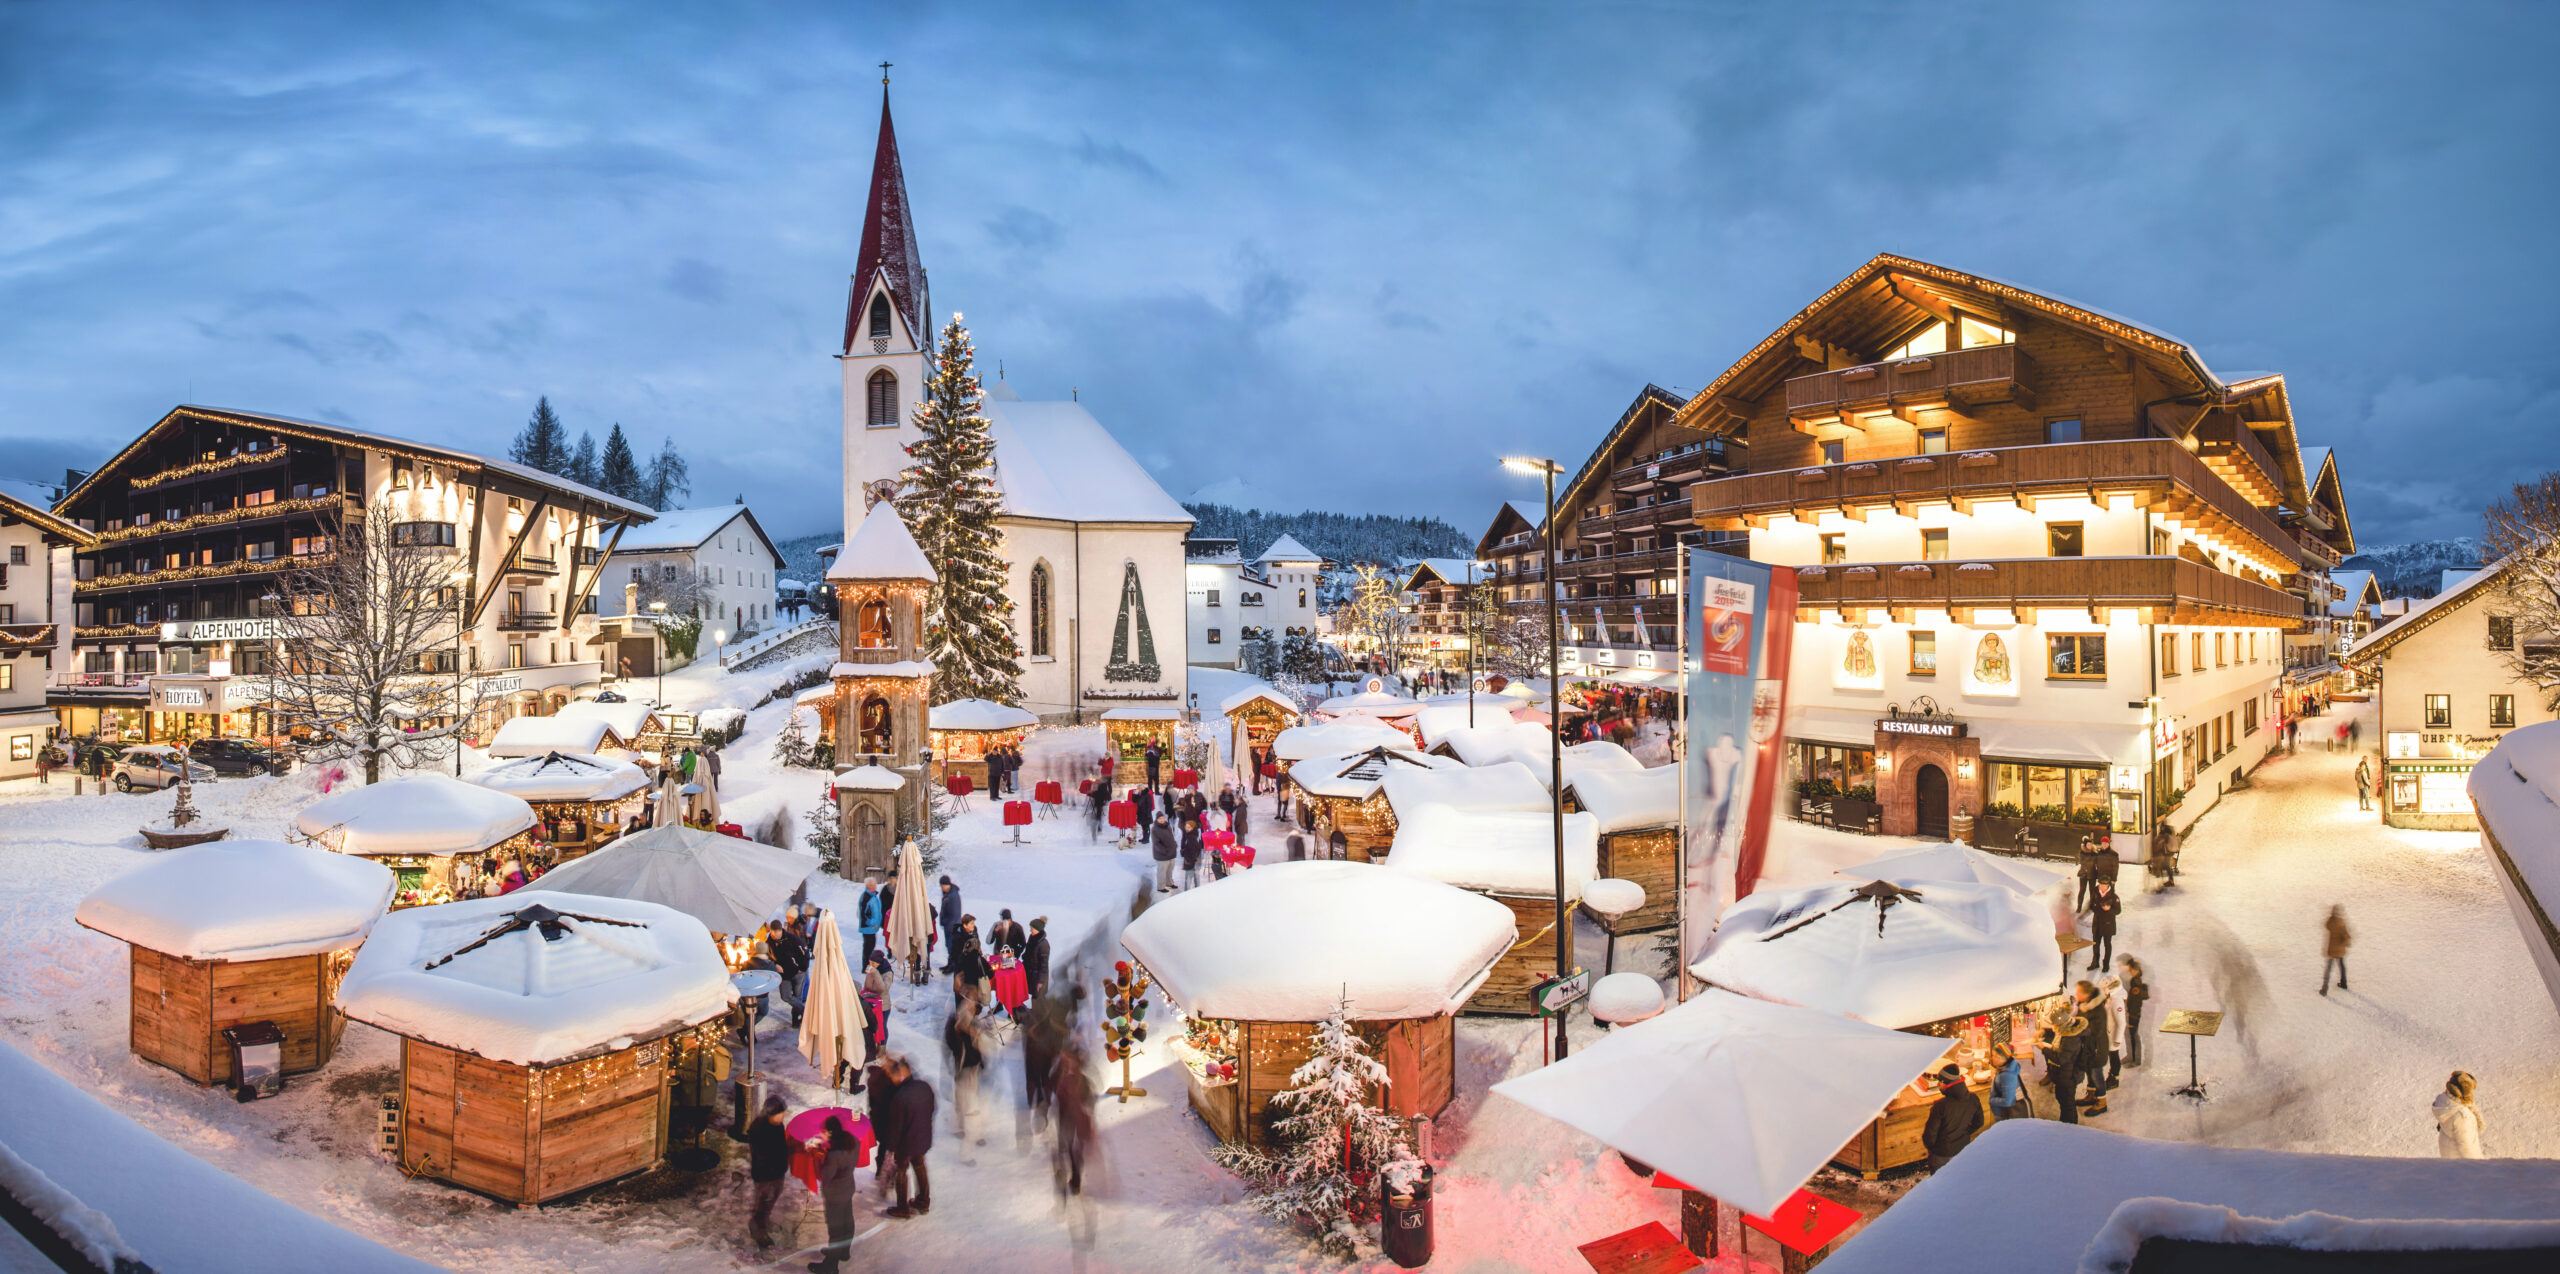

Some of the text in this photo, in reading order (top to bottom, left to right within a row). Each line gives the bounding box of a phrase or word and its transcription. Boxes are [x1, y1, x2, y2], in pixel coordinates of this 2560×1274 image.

[1713, 595, 1735, 606] 2019
[166, 690, 201, 704] HOTEL
[1882, 721, 1954, 736] RESTAURANT
[2422, 734, 2462, 743] UHREN
